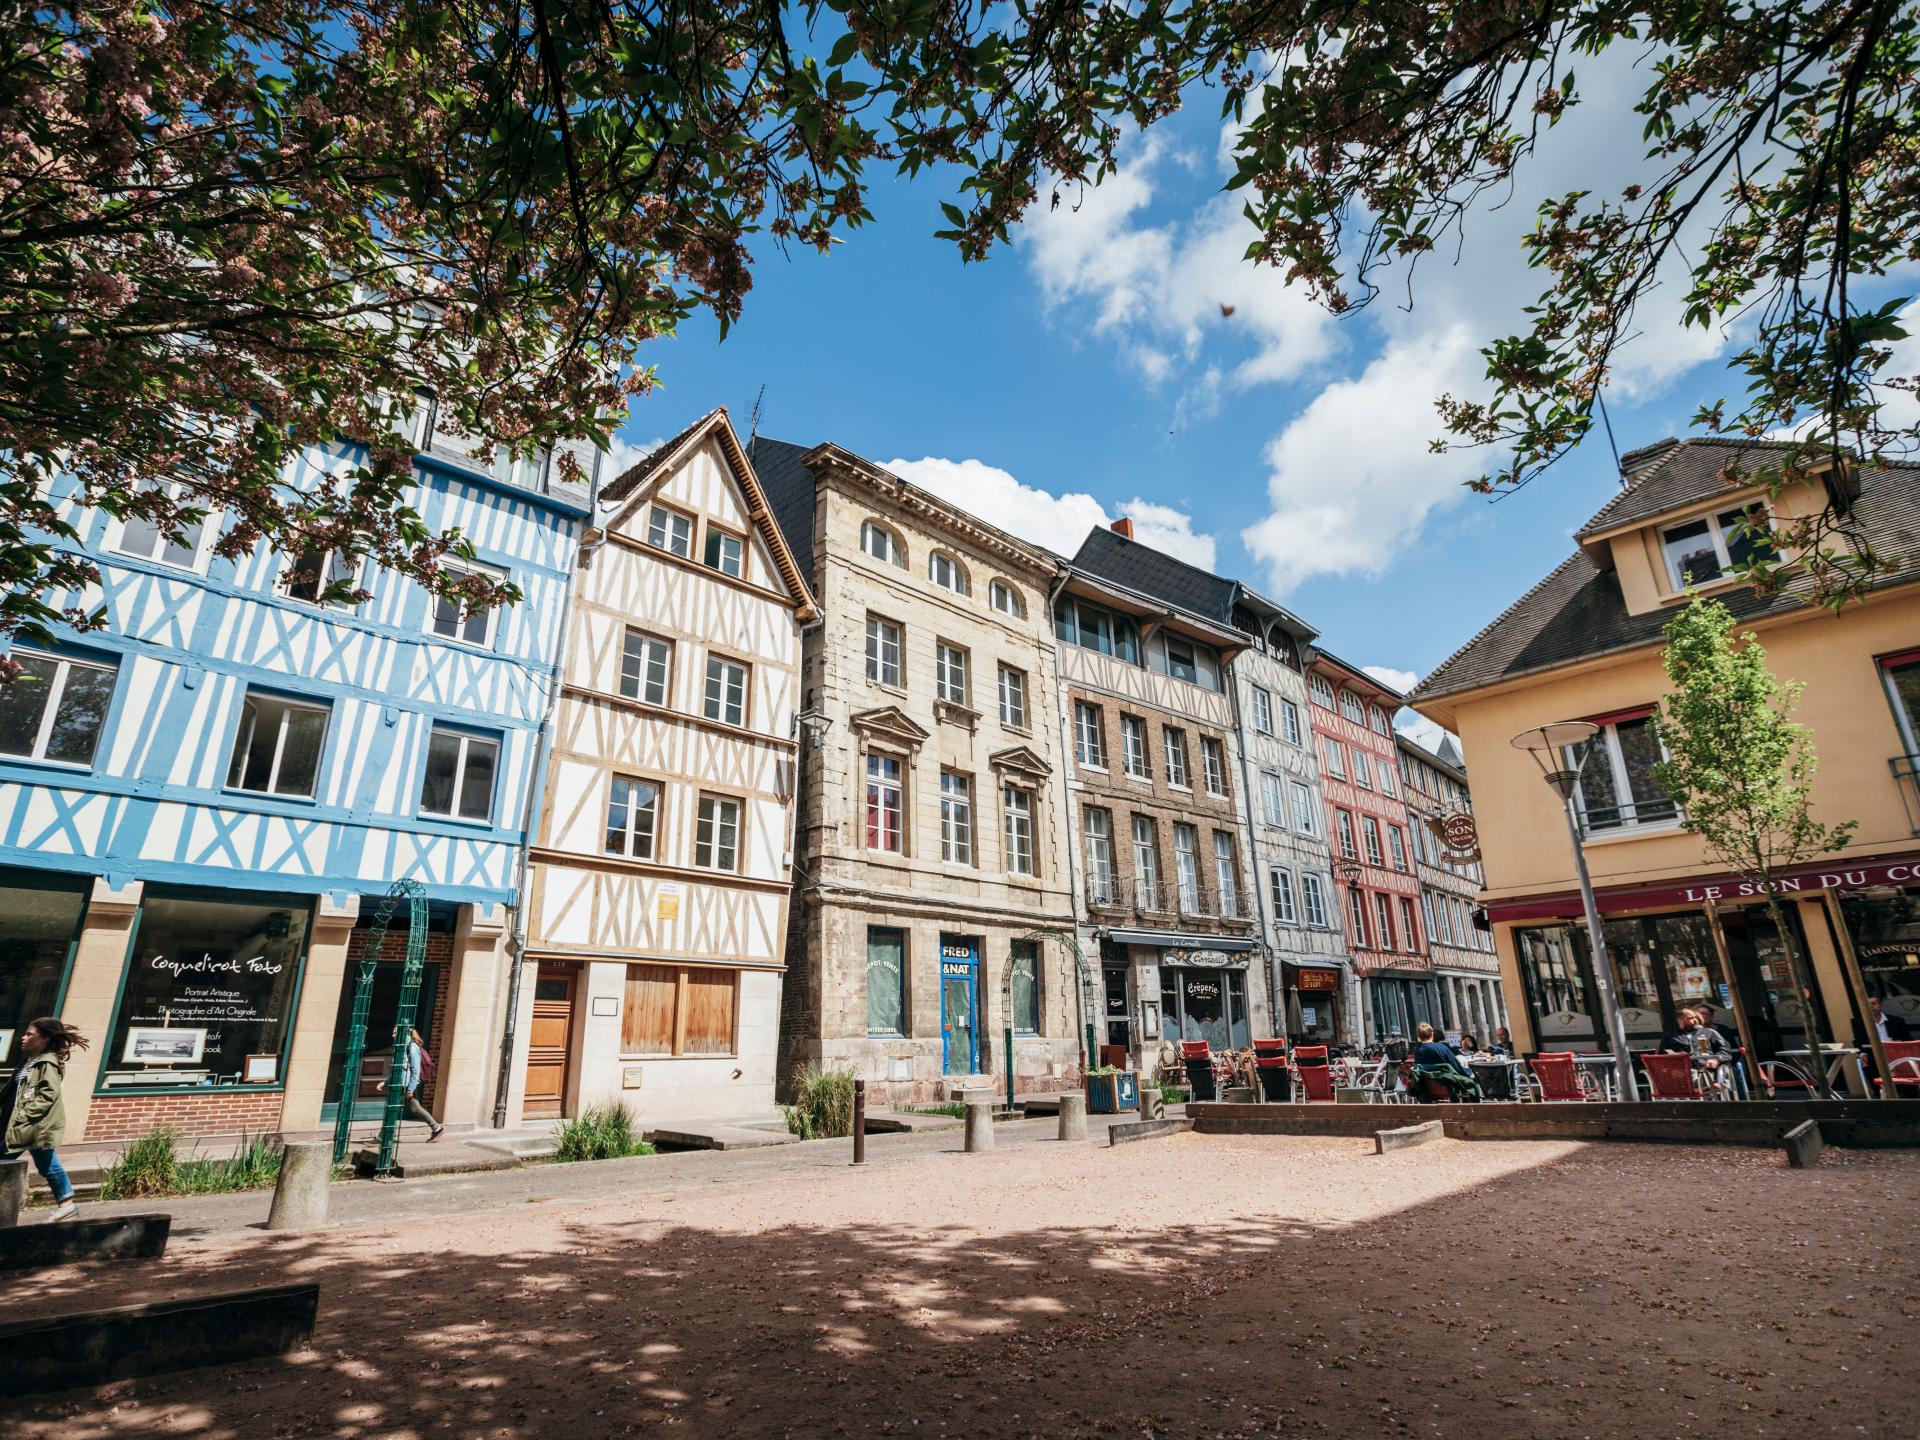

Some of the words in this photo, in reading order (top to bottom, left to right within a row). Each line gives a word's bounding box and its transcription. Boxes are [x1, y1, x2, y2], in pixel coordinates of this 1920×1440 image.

[1448, 825, 1474, 836] SON
[1686, 886, 1722, 902] LE
[1739, 878, 1801, 896] SON
[1818, 870, 1867, 888] DU
[943, 945, 969, 958] FRED
[152, 953, 241, 977] Coquelicot
[247, 956, 282, 974] Foto
[943, 963, 970, 976] &NAT
[184, 987, 209, 995] Portrait
[209, 987, 241, 1000] Artistique
[1187, 982, 1218, 995] Crêperie
[206, 1006, 225, 1016] d'Art
[226, 1006, 257, 1018] Originale
